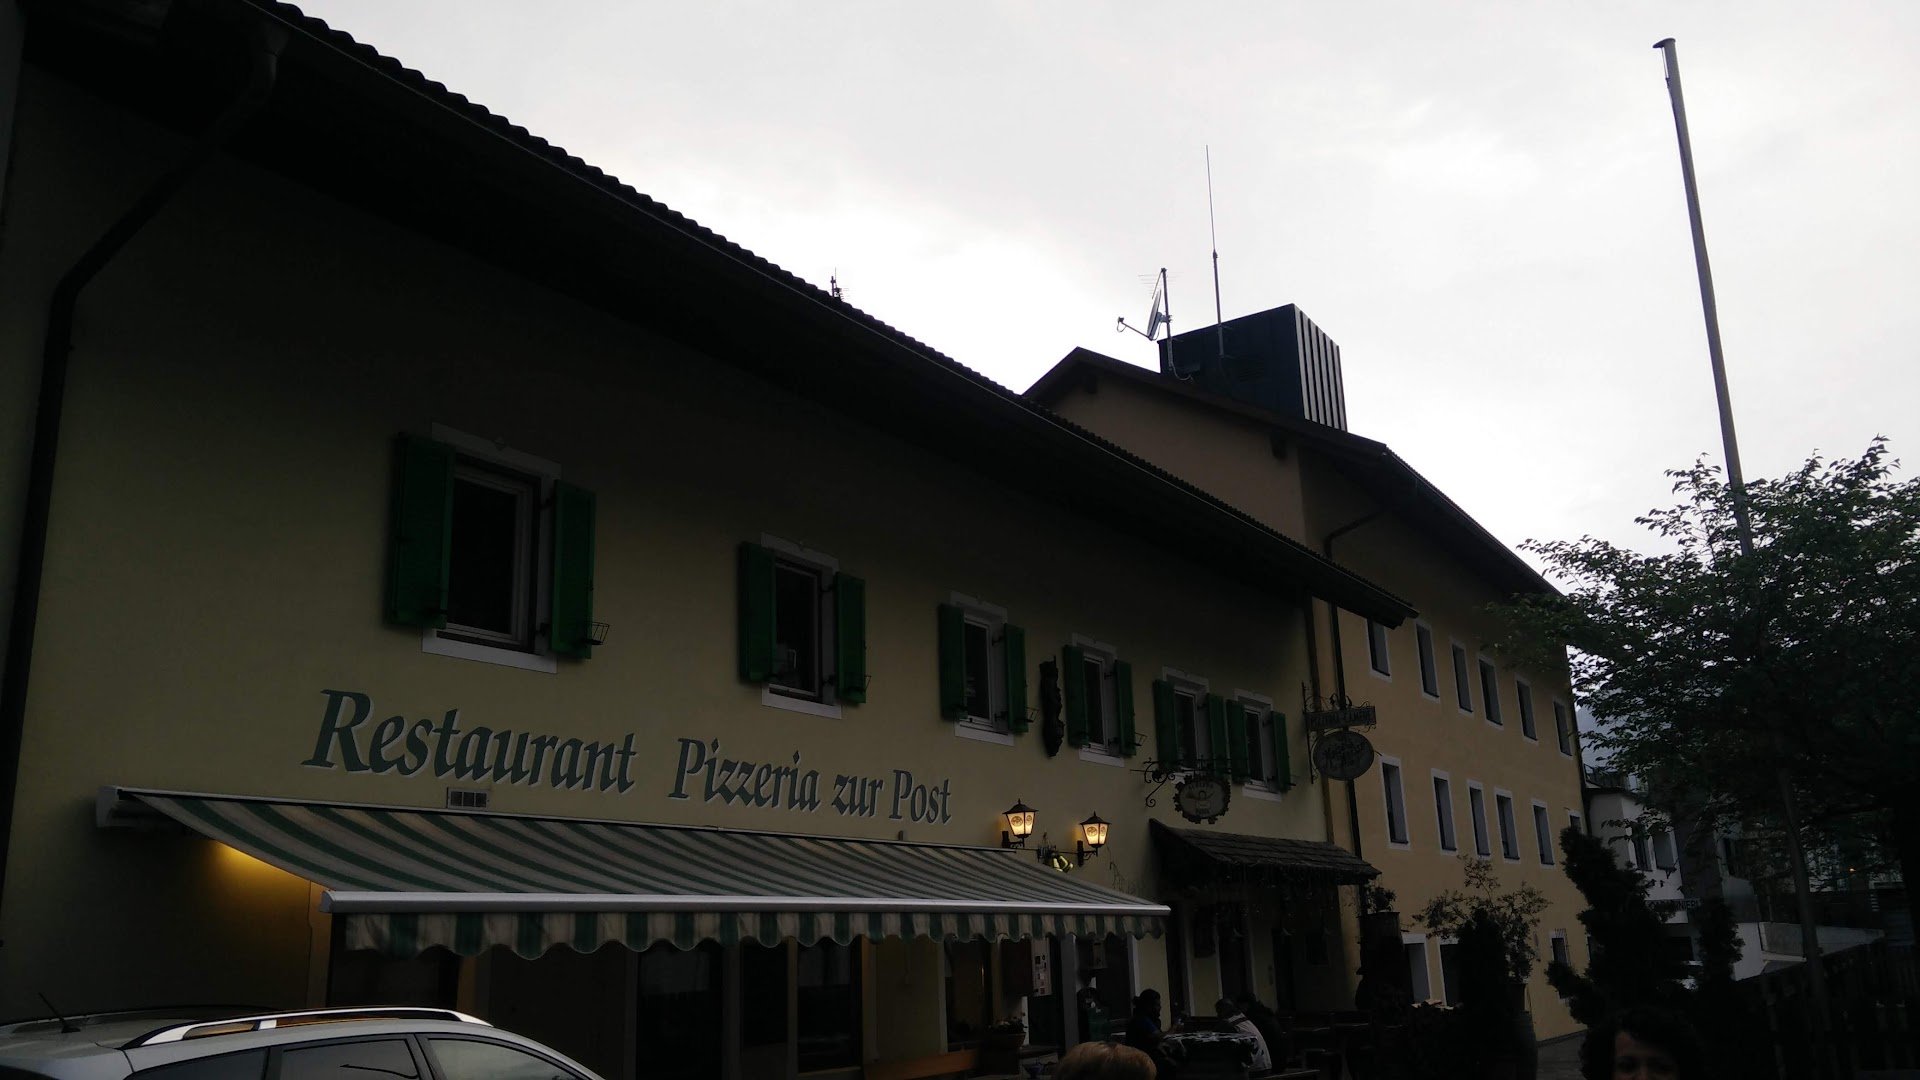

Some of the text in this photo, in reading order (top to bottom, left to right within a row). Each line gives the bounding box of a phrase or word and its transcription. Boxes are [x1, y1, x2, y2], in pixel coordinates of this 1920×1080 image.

[301, 689, 952, 825] Restaurant Pizzeria zur Post
